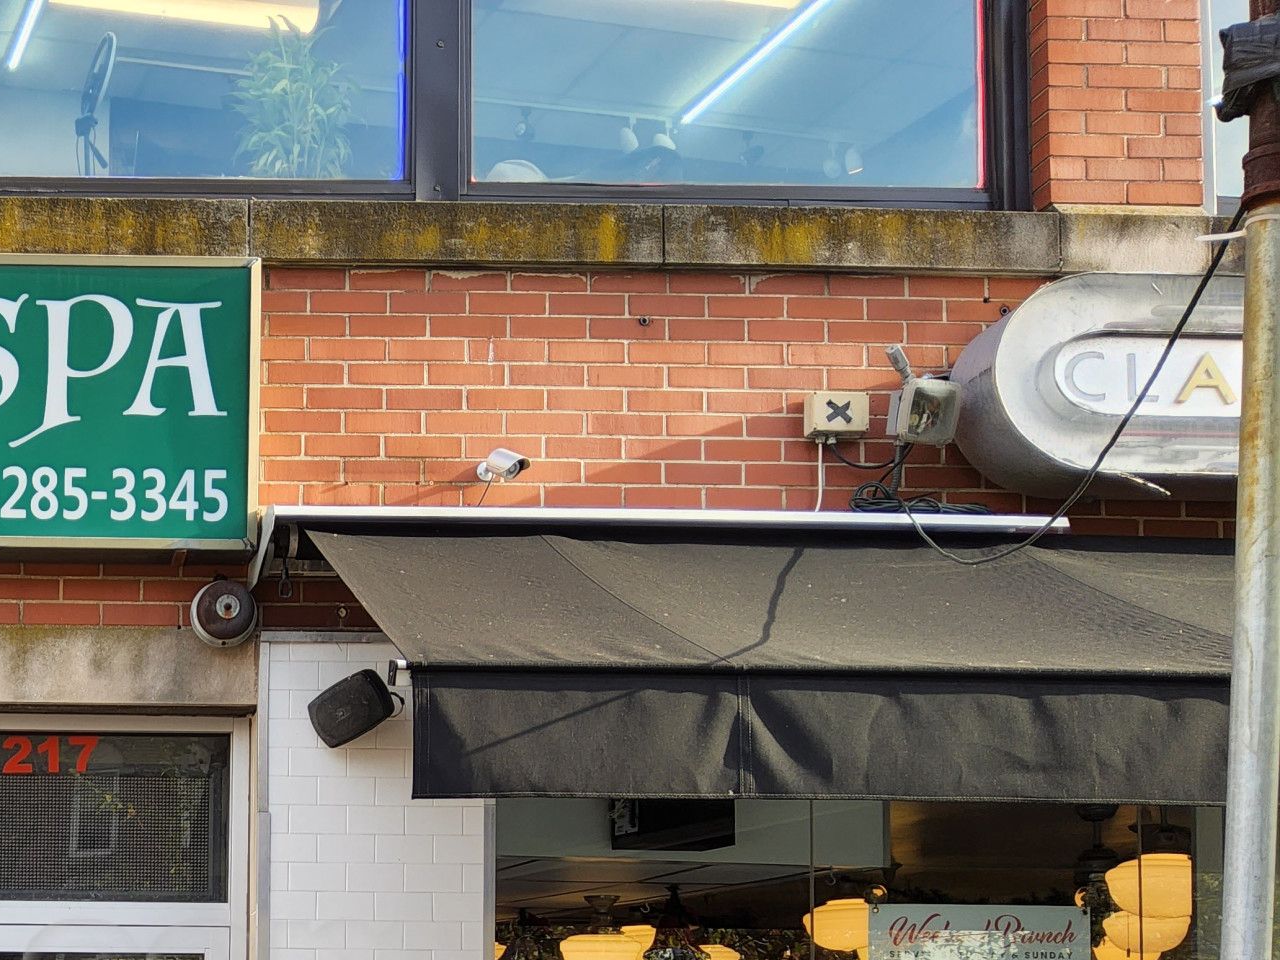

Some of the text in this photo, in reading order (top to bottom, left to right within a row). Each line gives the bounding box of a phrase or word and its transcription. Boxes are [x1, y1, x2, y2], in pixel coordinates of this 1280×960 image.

[1064, 351, 1238, 405] CLA
[0, 466, 229, 522] 285-3345
[2, 735, 100, 775] 217
[1025, 951, 1073, 959] SUNDAY
